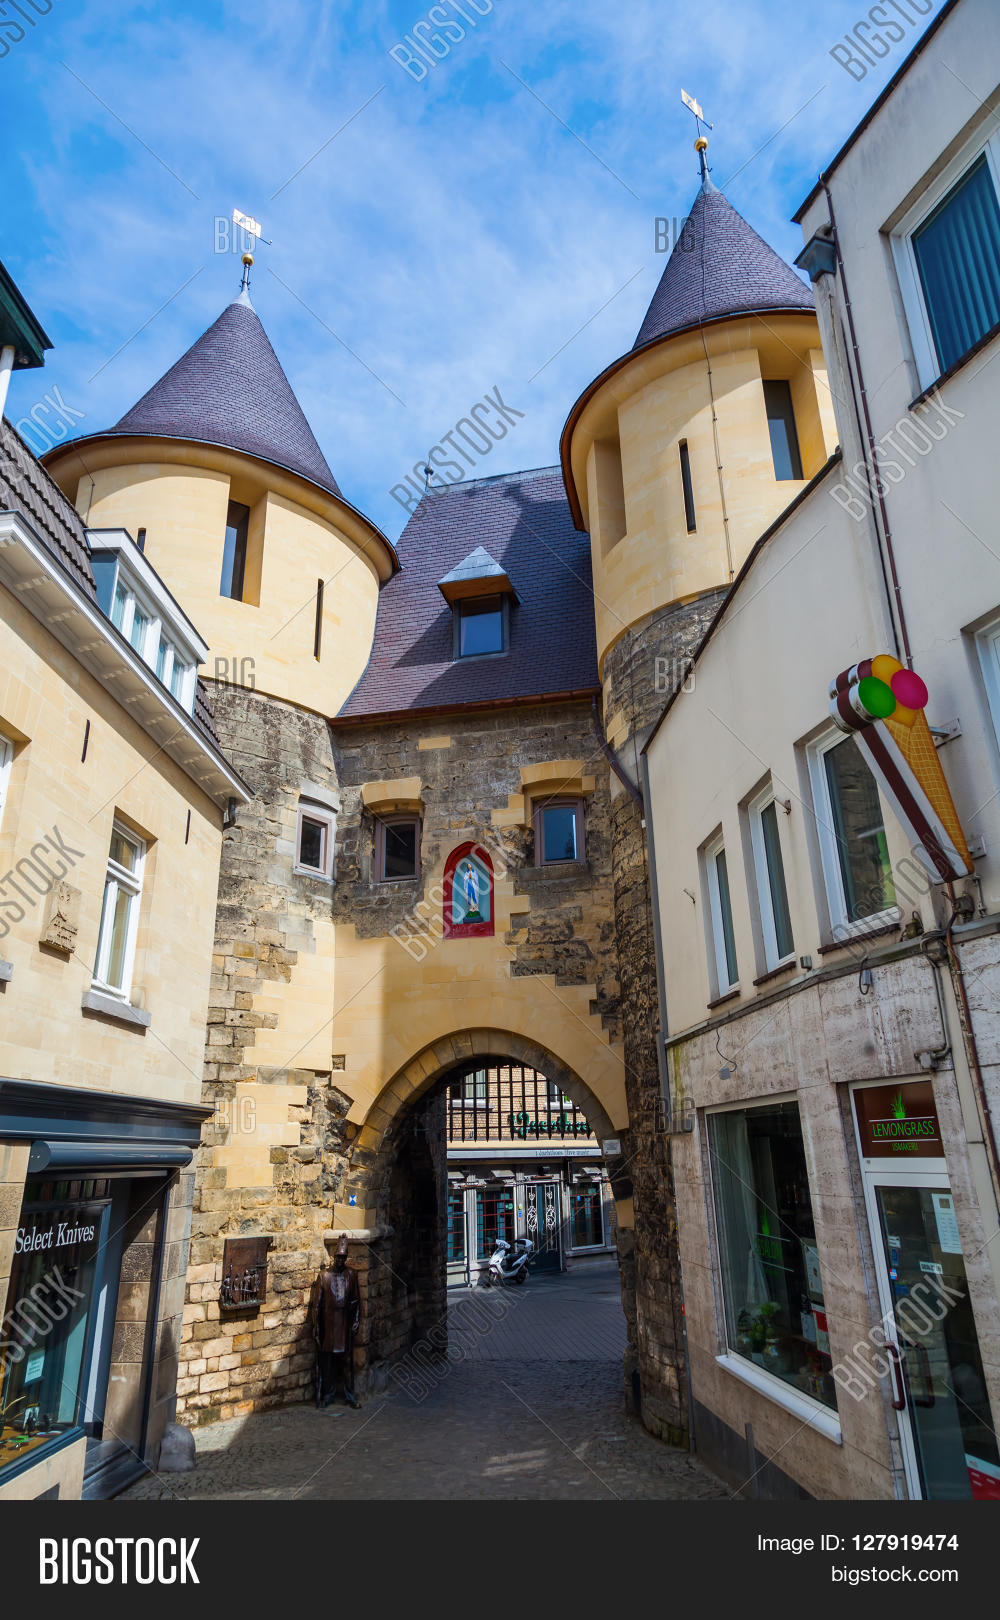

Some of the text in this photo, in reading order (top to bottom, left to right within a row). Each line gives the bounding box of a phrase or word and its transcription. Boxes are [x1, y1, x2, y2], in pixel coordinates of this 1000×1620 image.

[872, 1120, 935, 1137] LEMONGRASS
[15, 1221, 95, 1254] Select Knives
